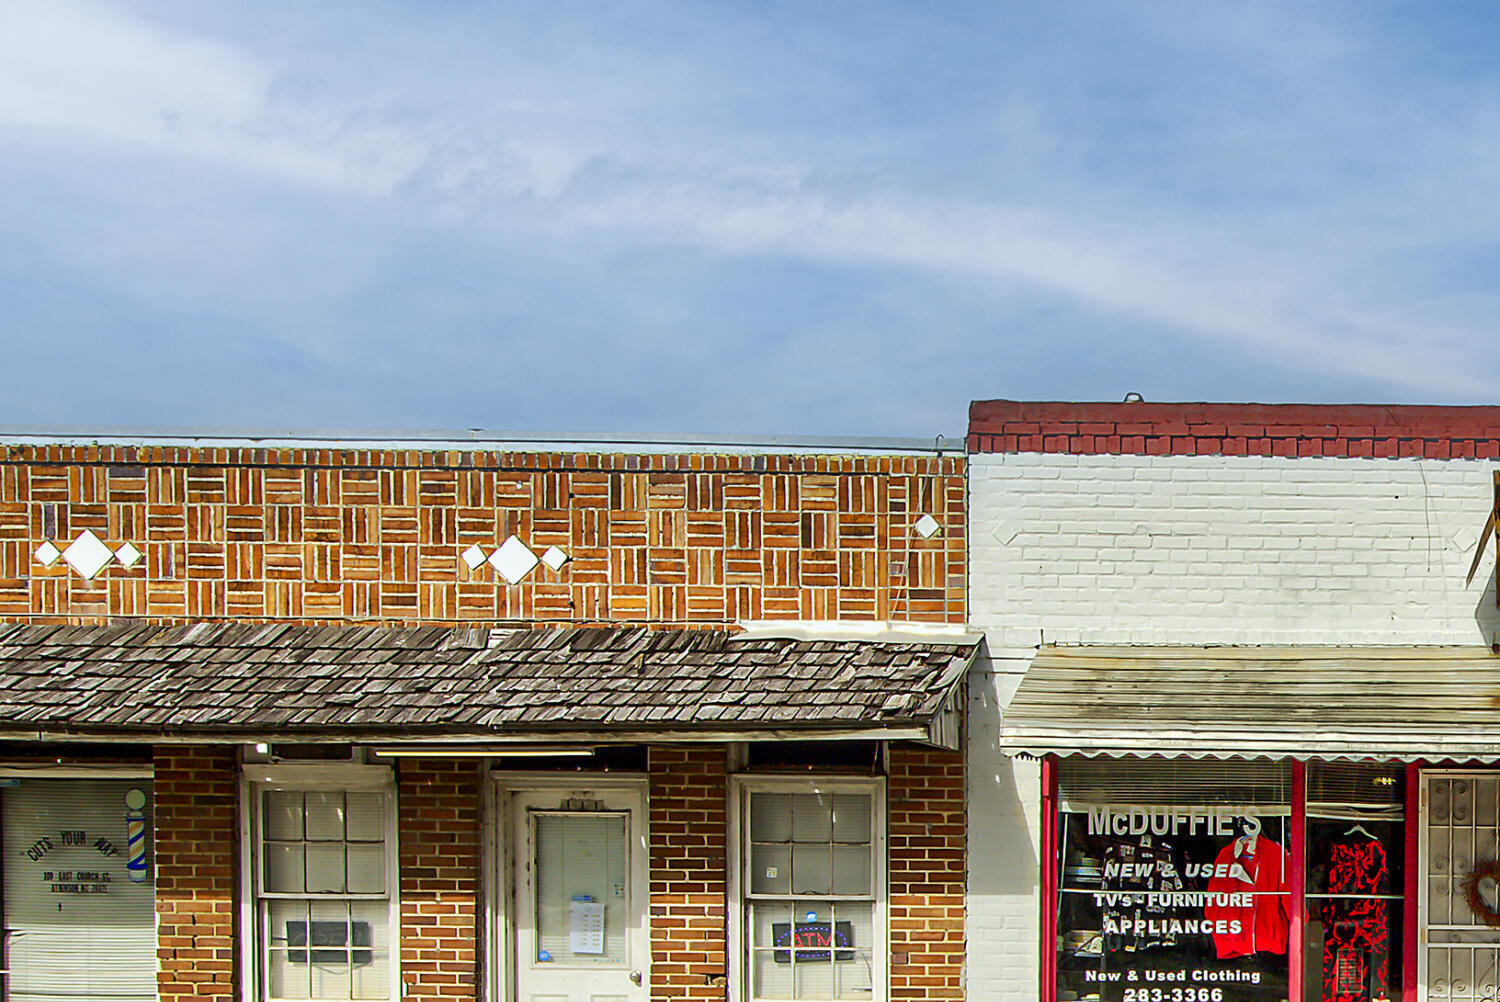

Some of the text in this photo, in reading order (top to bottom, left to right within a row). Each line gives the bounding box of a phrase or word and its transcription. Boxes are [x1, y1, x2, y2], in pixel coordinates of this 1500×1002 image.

[1088, 805, 1262, 836] McDUFFIE'S
[27, 837, 54, 861] CUTS
[61, 831, 87, 846] YOUR
[1104, 863, 1243, 878] NEW & USED
[1093, 893, 1131, 907] TV's
[1148, 893, 1254, 907] FURNITURE
[1105, 919, 1242, 934] APPLIANCES
[794, 932, 833, 947] ATM
[1085, 970, 1261, 984] New & Used Clothing
[1124, 988, 1223, 1002] 283-3366
